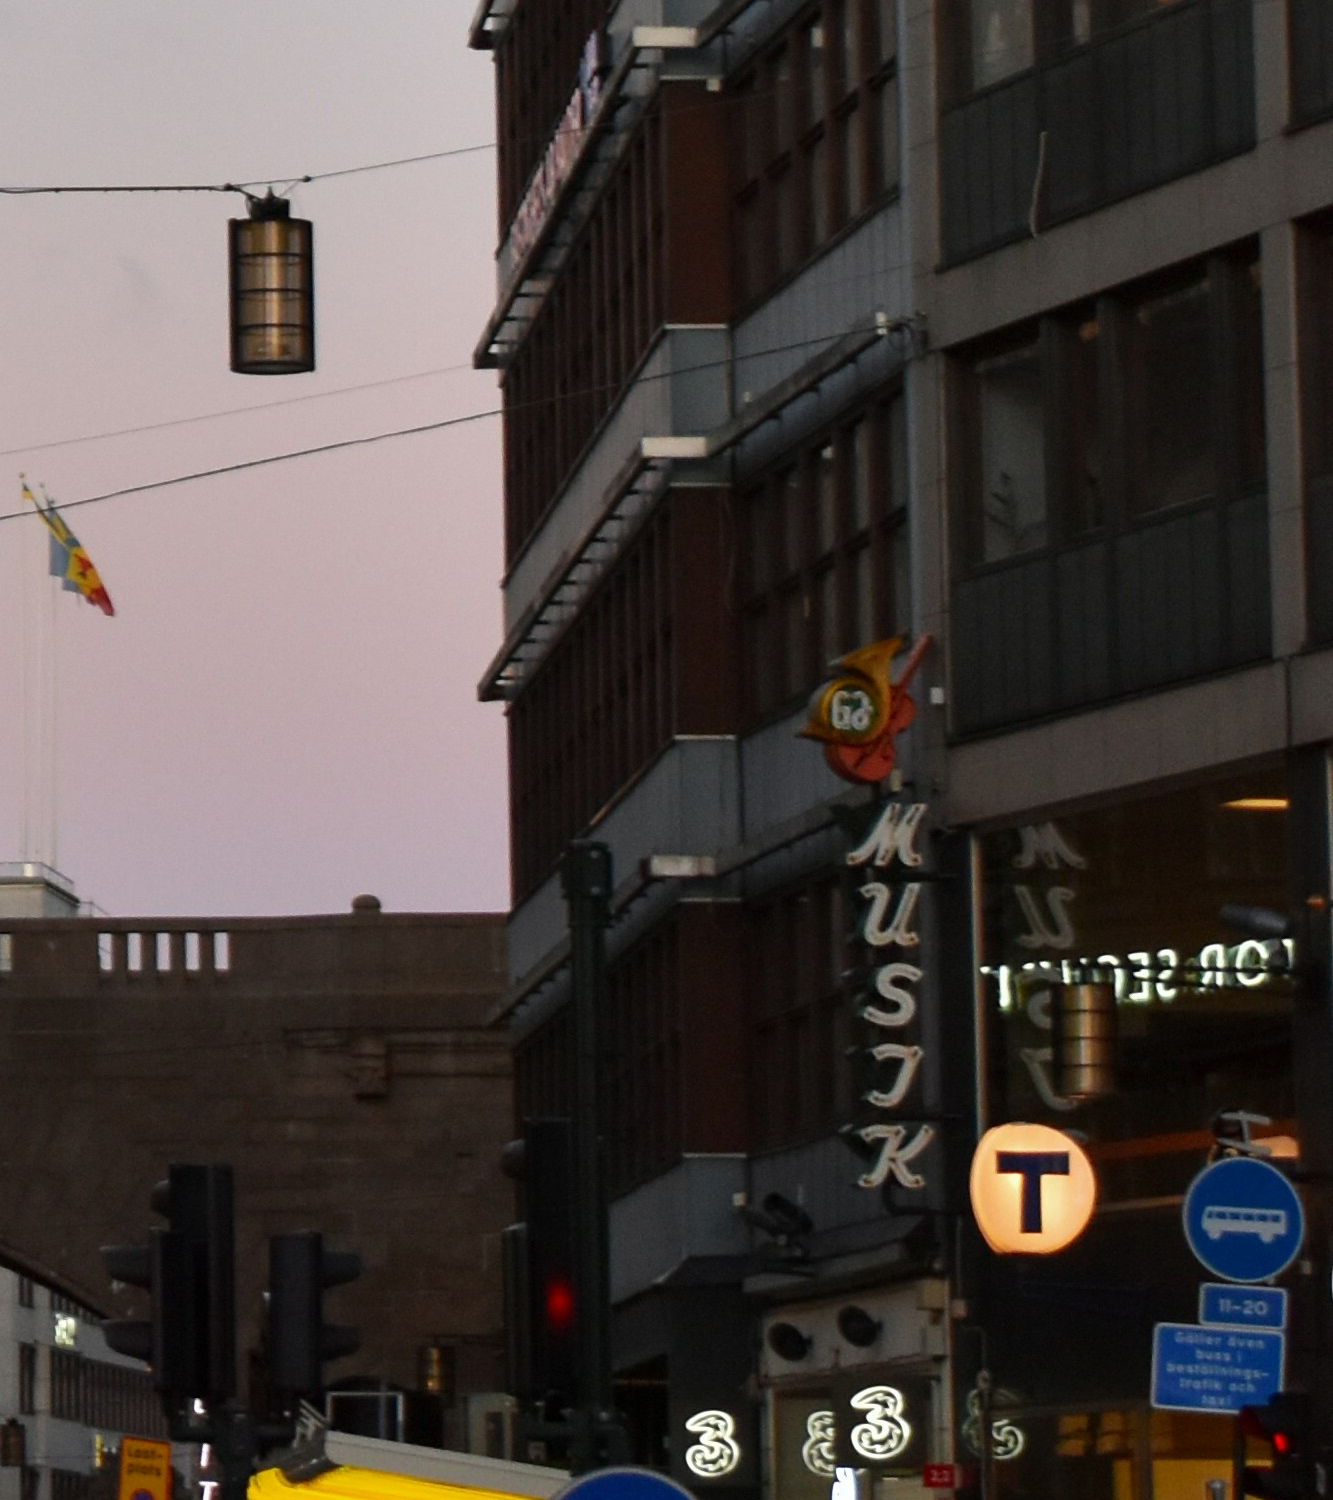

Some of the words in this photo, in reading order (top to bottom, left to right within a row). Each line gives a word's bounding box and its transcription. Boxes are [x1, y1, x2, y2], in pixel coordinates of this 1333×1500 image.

[995, 1151, 1070, 1233] T
[1218, 1298, 1269, 1316] 11-20
[685, 1410, 740, 1478] 3
[850, 1385, 911, 1460] 3
